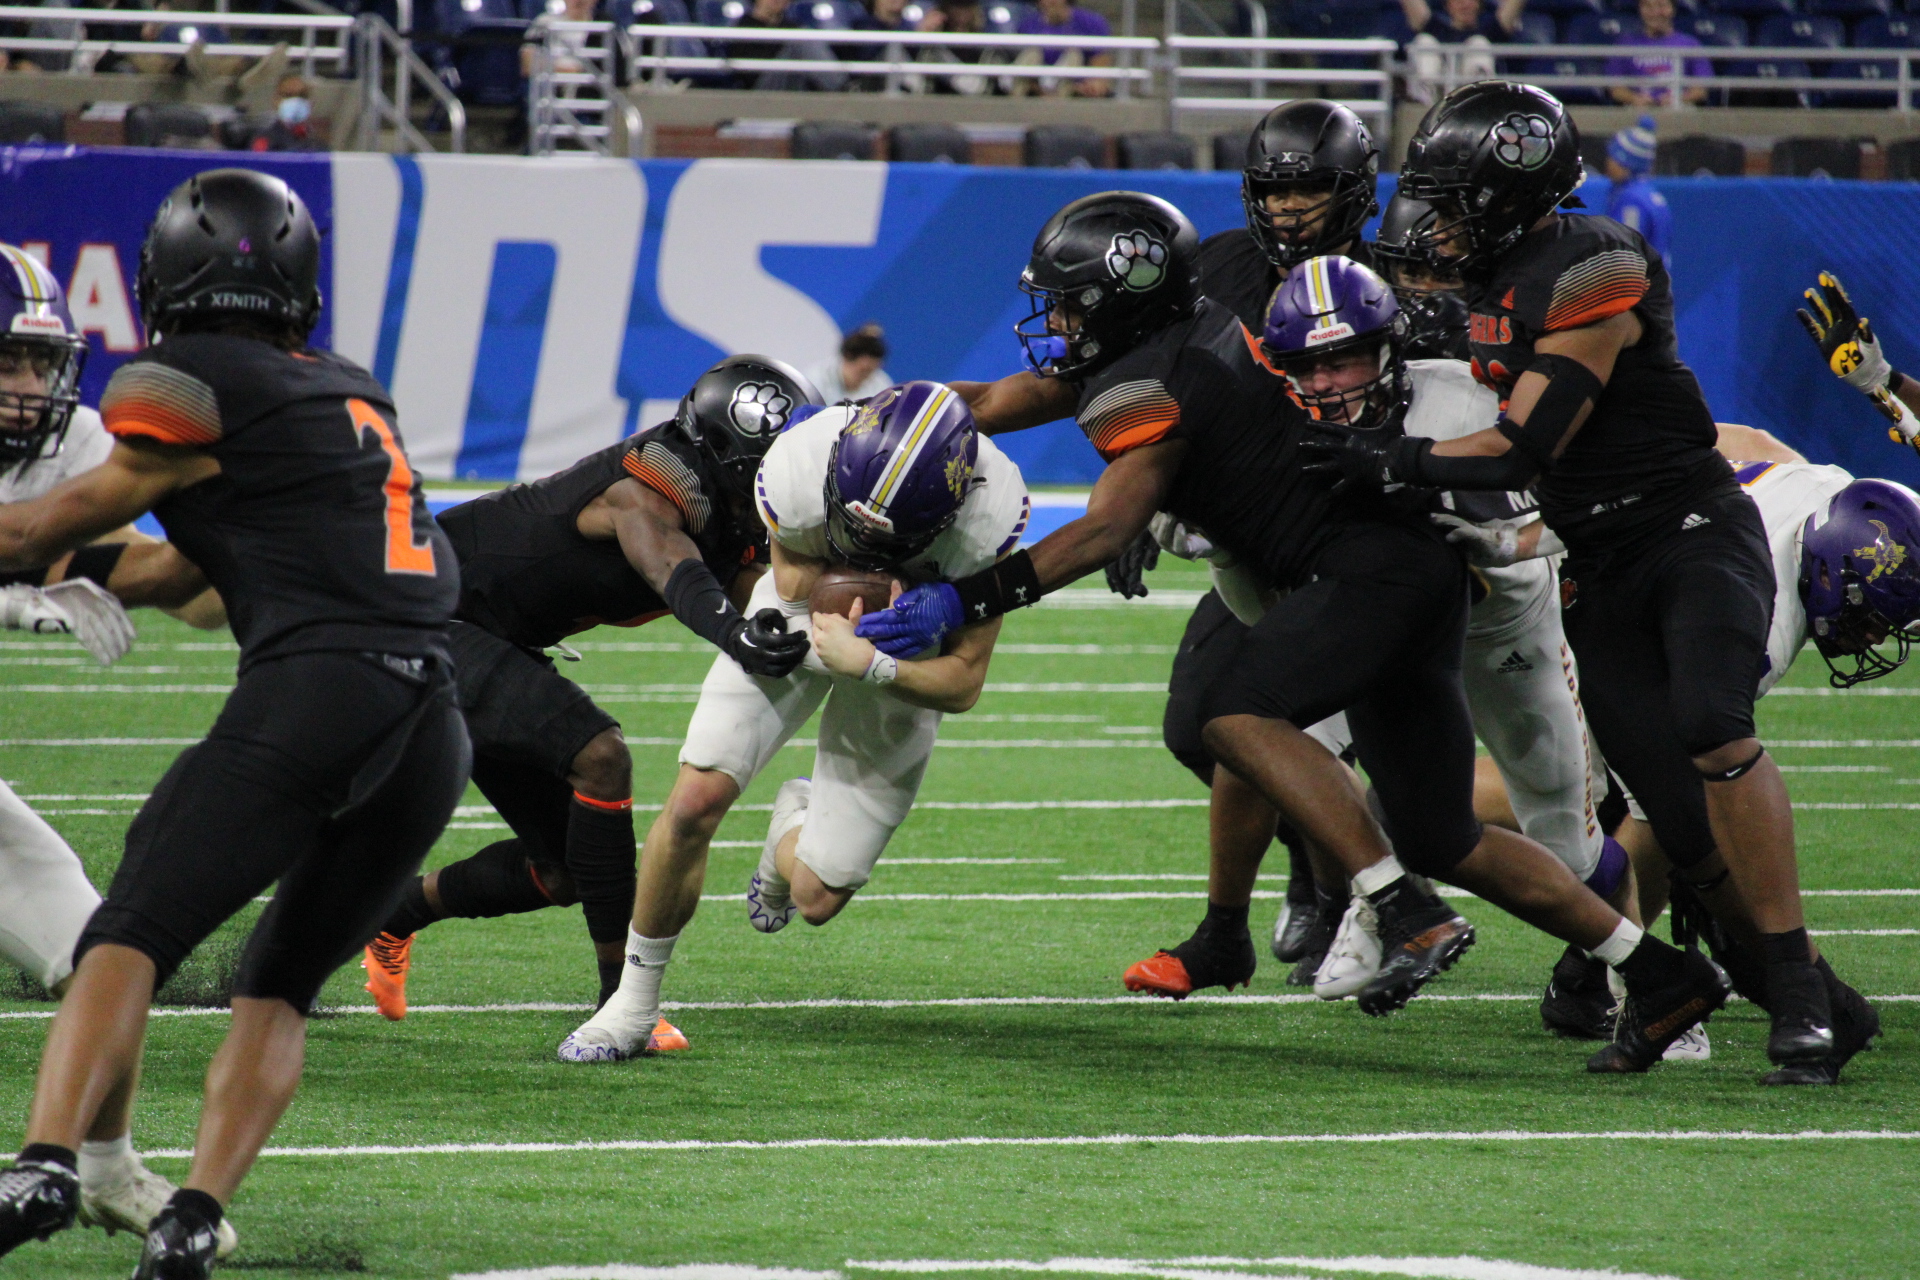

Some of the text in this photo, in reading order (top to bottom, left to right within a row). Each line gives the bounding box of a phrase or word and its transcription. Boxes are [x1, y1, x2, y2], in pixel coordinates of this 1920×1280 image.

[211, 293, 270, 310] XENITH
[345, 398, 437, 578] 2
[854, 505, 889, 529] Riddell
[1497, 663, 1534, 674] adidas
